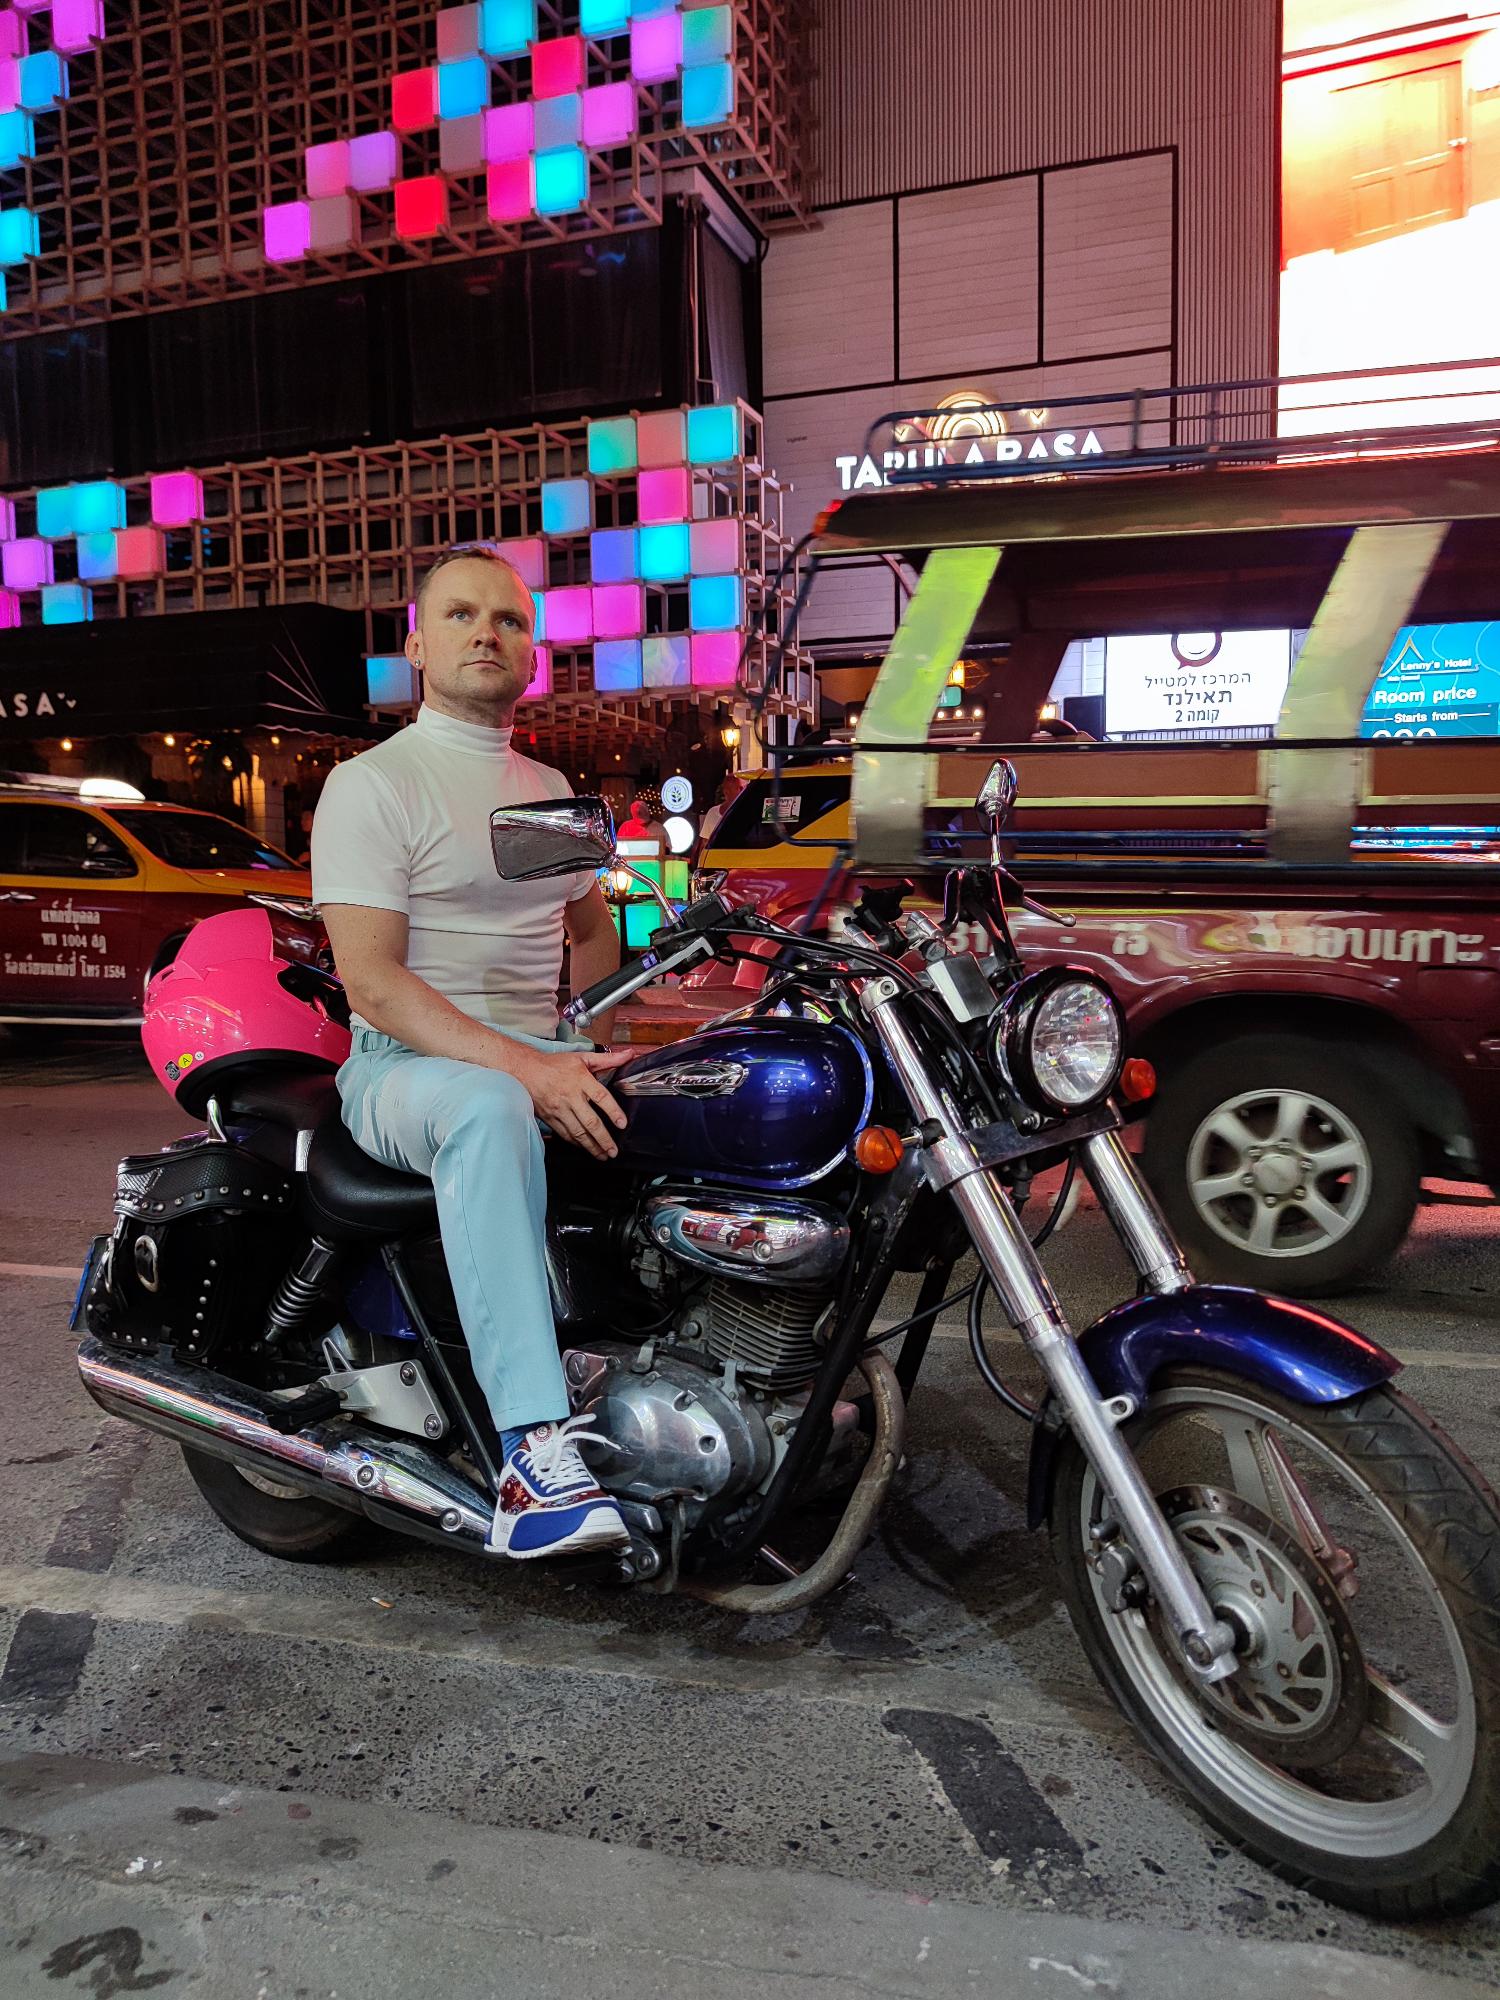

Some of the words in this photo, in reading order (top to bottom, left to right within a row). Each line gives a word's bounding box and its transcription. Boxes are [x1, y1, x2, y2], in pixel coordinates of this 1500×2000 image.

[1444, 658, 1472, 668] Hotel
[1145, 674, 1197, 688] למטייל
[1202, 672, 1251, 686] המרכז
[1163, 689, 1232, 706] תאילנד
[1374, 690, 1425, 704] Room
[1432, 687, 1477, 703] price
[1175, 710, 1183, 723] 2
[1187, 708, 1220, 723] קומה
[1394, 712, 1427, 723] Starts
[1431, 711, 1459, 721] from
[103, 965, 126, 979] 1584
